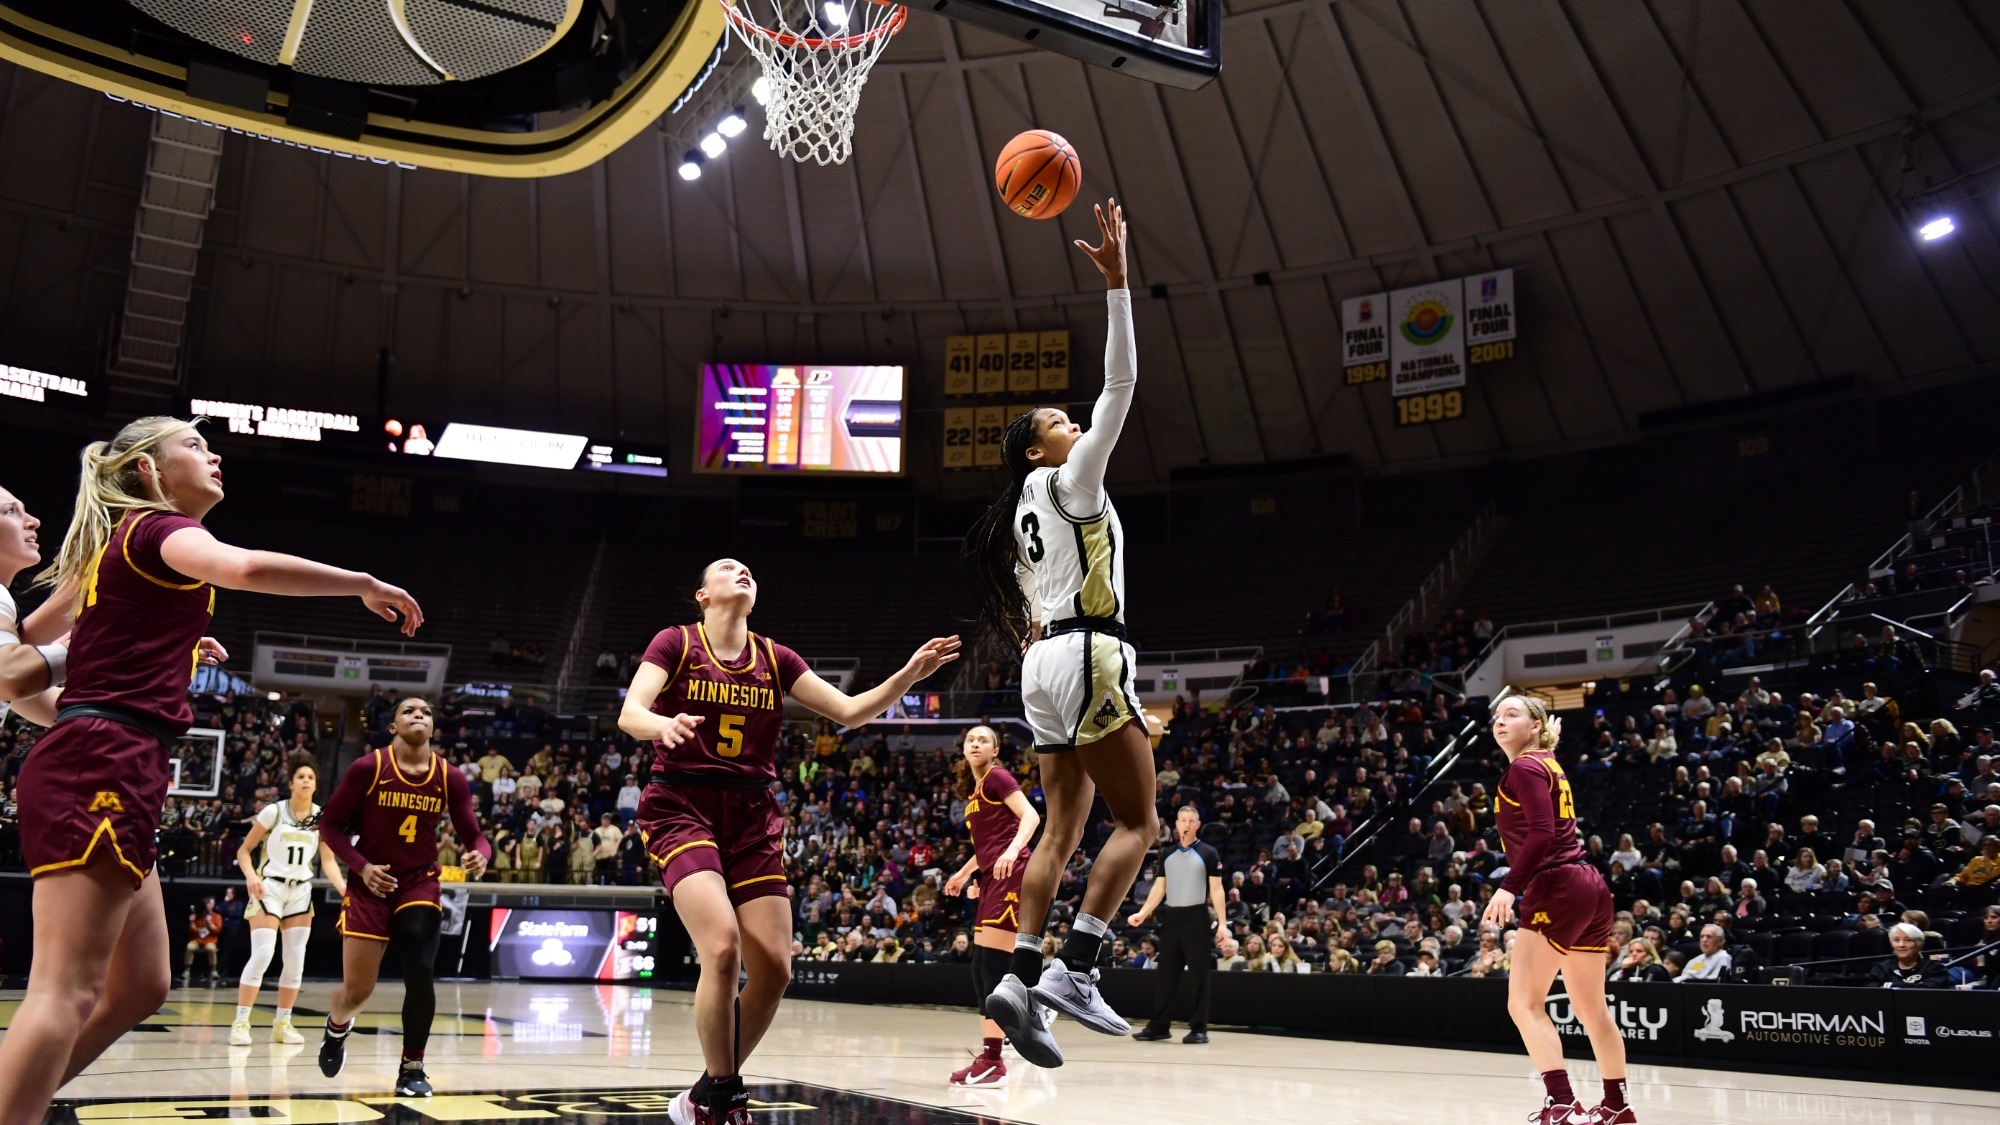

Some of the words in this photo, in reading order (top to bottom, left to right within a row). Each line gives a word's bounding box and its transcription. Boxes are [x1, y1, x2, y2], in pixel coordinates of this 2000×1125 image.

[1015, 182, 1047, 214] ELITE
[1469, 303, 1511, 322] FINAL
[1346, 326, 1384, 343] FINAL
[1472, 318, 1508, 336] FOUR
[1349, 341, 1382, 357] FOUR
[1470, 339, 1514, 364] 2001
[949, 355, 970, 373] 41
[979, 353, 1003, 372] 40
[1010, 352, 1035, 370] 22
[1041, 350, 1066, 369] 32
[1400, 354, 1455, 371] NATIONAL
[1346, 361, 1387, 384] 1994
[1396, 364, 1461, 384] CHAMPIONS
[191, 399, 263, 421] WOMEN'S
[266, 407, 359, 432] BASKETBALL
[1398, 390, 1461, 424] 1999
[229, 417, 255, 434] VS.
[258, 420, 321, 441] INDIANA
[946, 428, 971, 446] 22
[978, 427, 1001, 445] 32
[353, 474, 414, 496] PAINT
[351, 494, 412, 517] CREW
[803, 501, 859, 519] PAINT
[803, 519, 858, 538] CREW
[876, 515, 902, 531] 107
[1021, 511, 1044, 563] 3
[687, 679, 774, 710] MINNESOTA
[717, 714, 745, 757] 5
[378, 791, 441, 813] MINNESOTA
[399, 815, 418, 843] 4
[287, 846, 304, 865] 11
[636, 917, 657, 933] 51
[632, 956, 655, 971] 66
[1740, 1010, 1885, 1034] ROHRMAN
[1746, 1030, 1830, 1045] AUTOMOTIVE
[1836, 1035, 1886, 1047] GROUP
[1950, 1029, 1993, 1038] LEXUS
